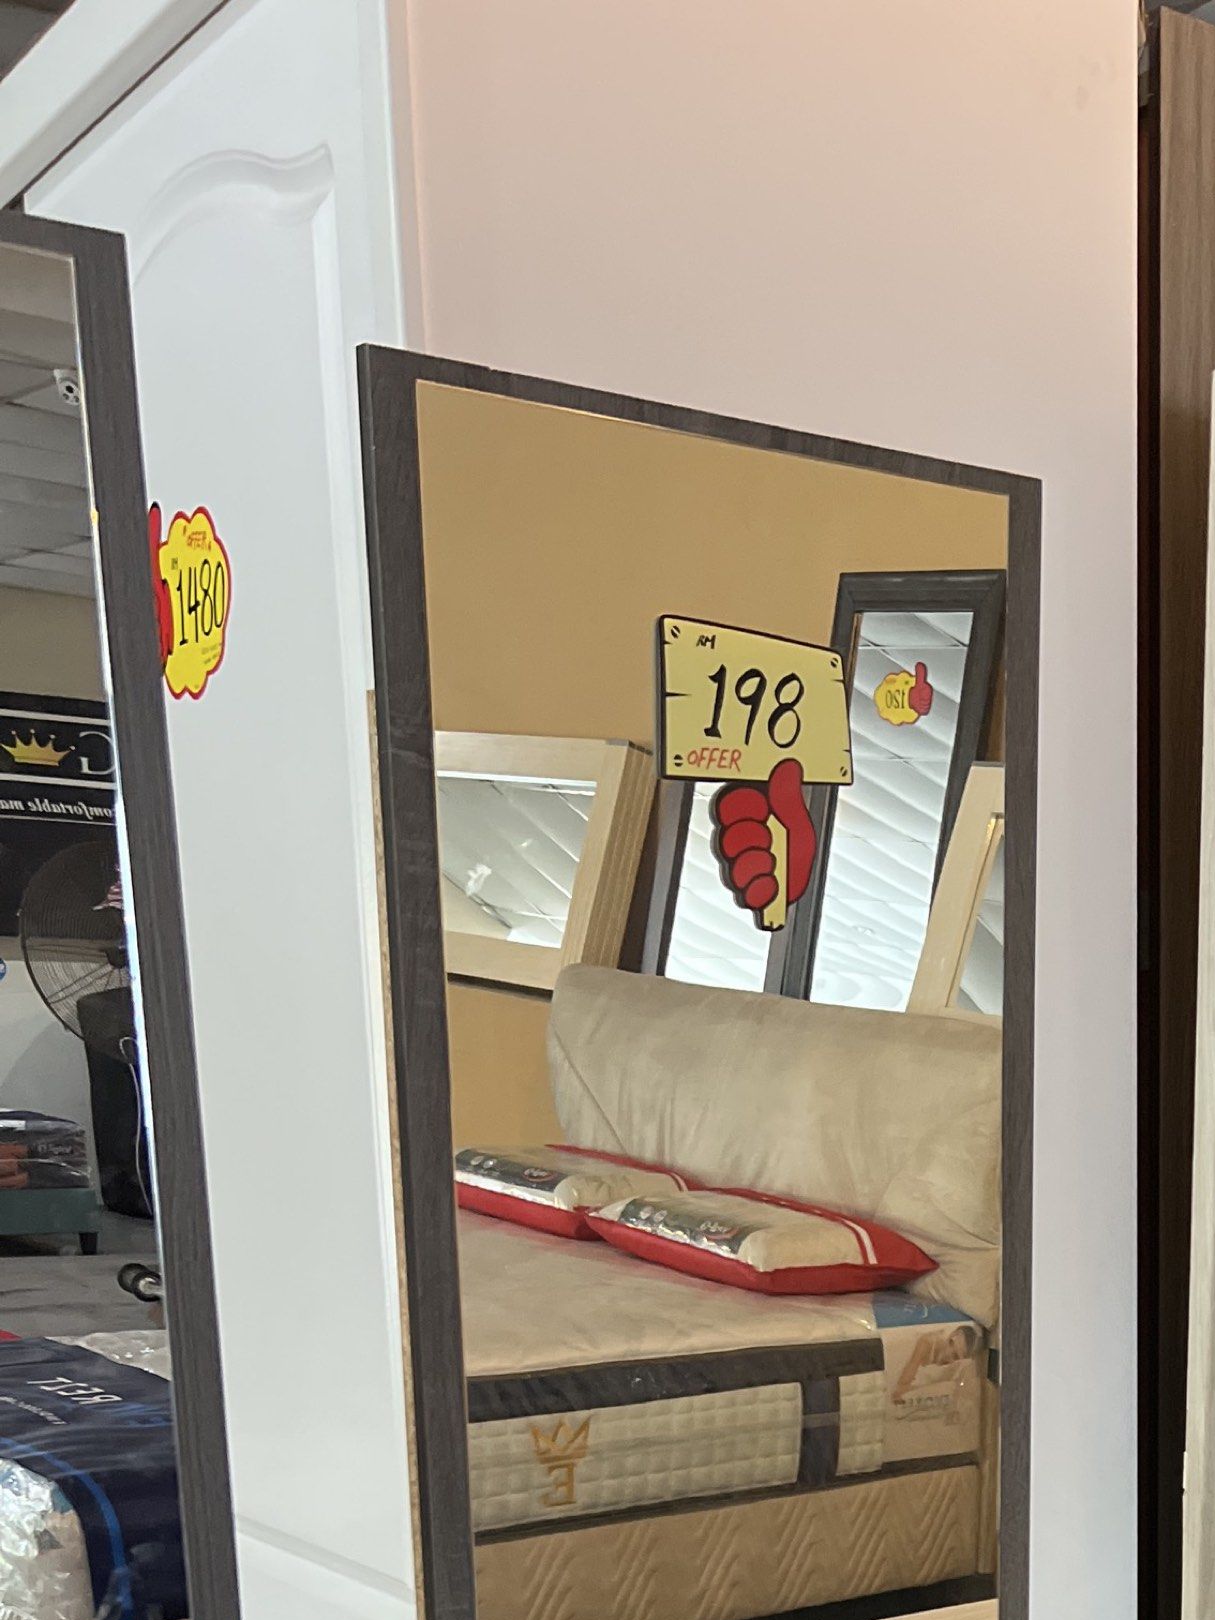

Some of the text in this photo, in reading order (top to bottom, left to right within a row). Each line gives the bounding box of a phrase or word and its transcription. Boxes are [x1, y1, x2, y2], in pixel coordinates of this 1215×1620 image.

[177, 558, 225, 646] 1480
[696, 634, 716, 650] RM
[703, 663, 805, 749] 198
[687, 747, 742, 772] OFFER
